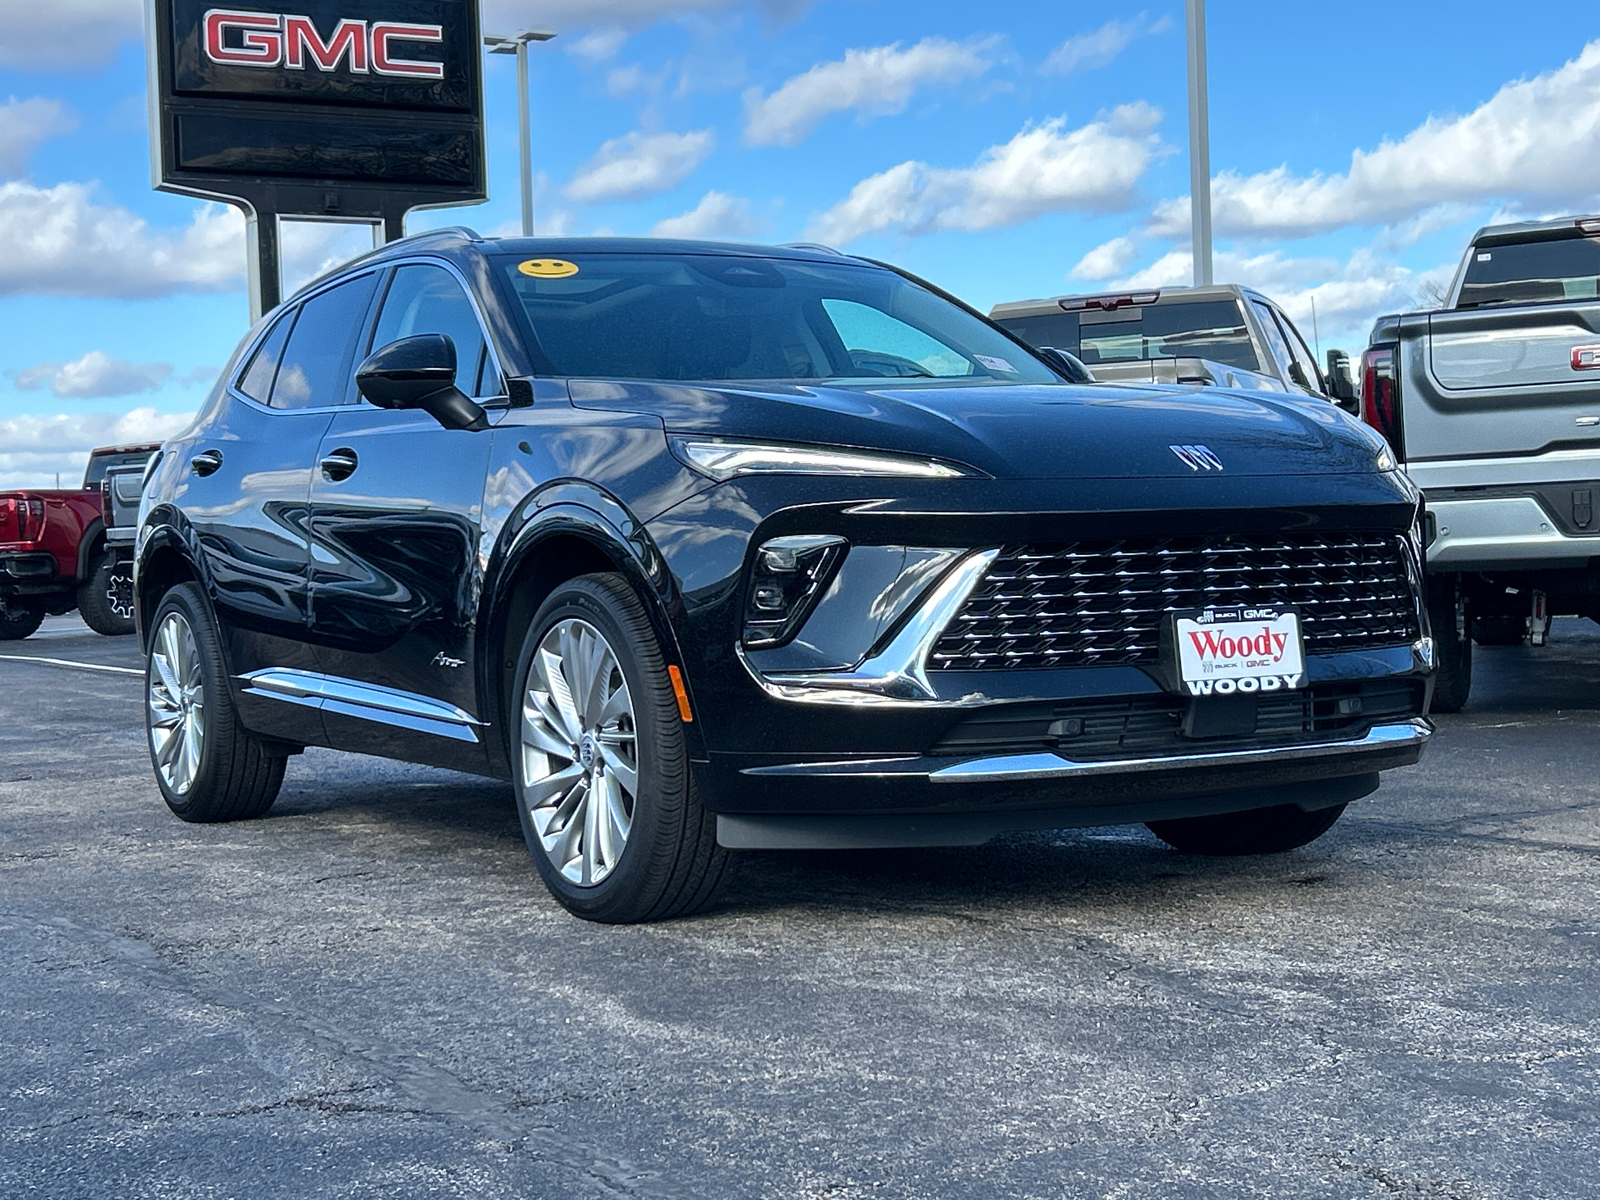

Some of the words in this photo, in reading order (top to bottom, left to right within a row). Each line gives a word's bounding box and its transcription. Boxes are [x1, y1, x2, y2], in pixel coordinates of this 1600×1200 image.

[203, 8, 444, 79] GMC
[1243, 608, 1273, 619] GMC
[1187, 626, 1289, 662] Woody
[1246, 659, 1271, 668] GMC
[1186, 673, 1302, 696] WOODY
